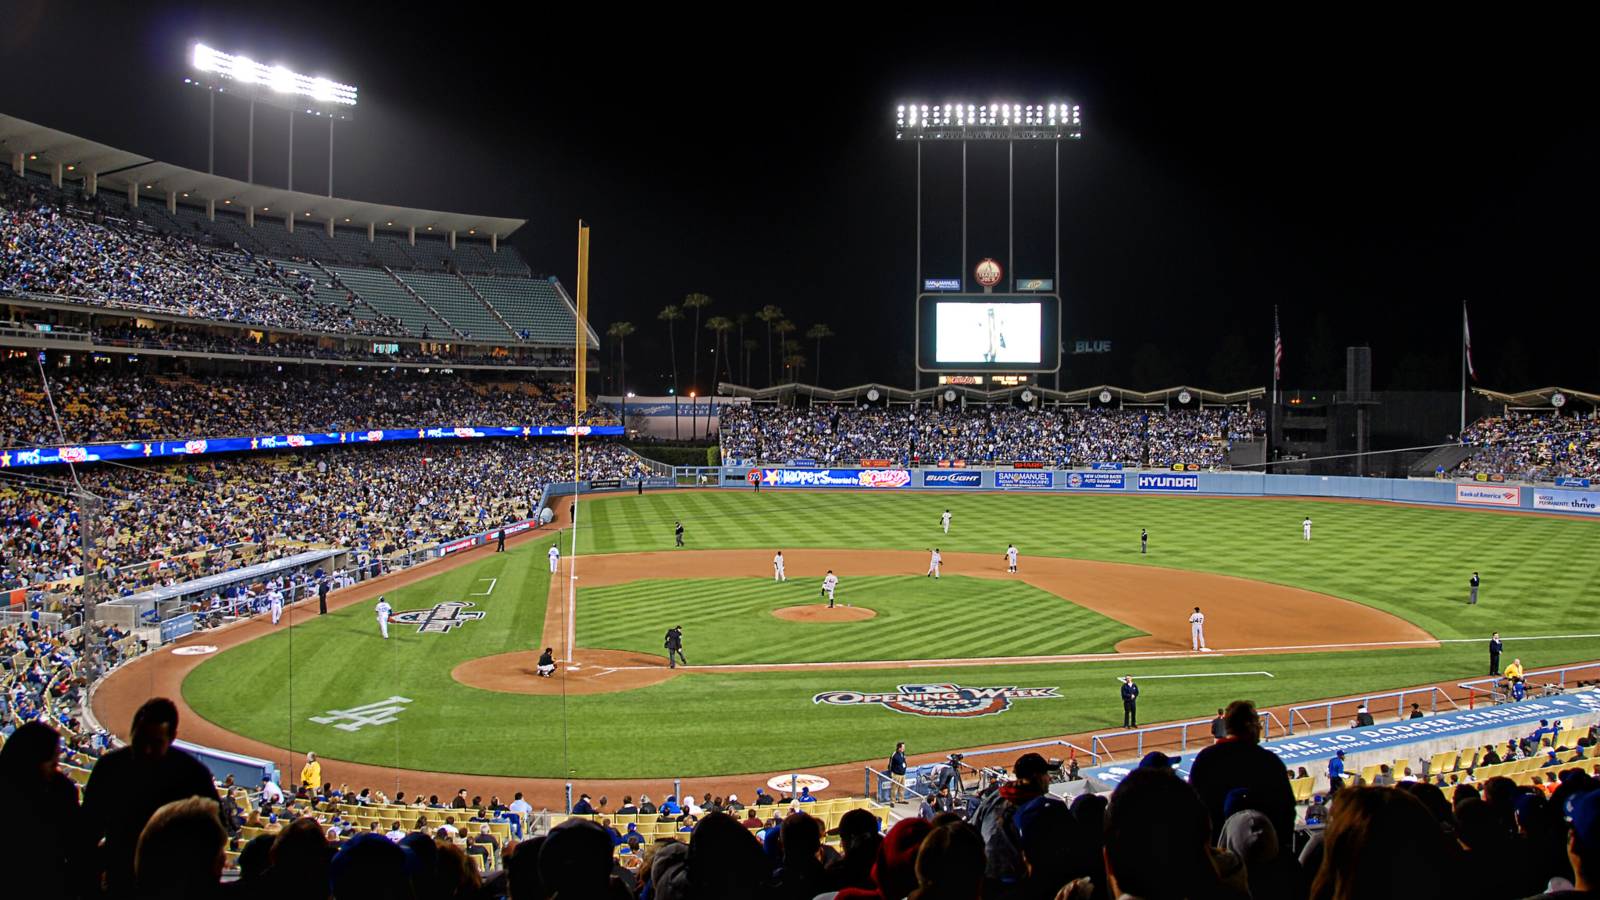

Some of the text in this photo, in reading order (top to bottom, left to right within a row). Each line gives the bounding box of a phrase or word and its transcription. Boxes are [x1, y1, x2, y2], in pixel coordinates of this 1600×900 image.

[1075, 340, 1112, 353] BLUE
[998, 472, 1013, 480] SAN
[1139, 477, 1197, 487] HYUNDAI
[1571, 498, 1596, 509] thrive
[813, 687, 1055, 705] OPENING WEEK
[1264, 703, 1550, 754] OME TO DODGER STADIUM
[1300, 741, 1370, 756] DEFENDING
[1371, 729, 1431, 744] NATIONAL
[1431, 722, 1474, 734] LEAGUE
